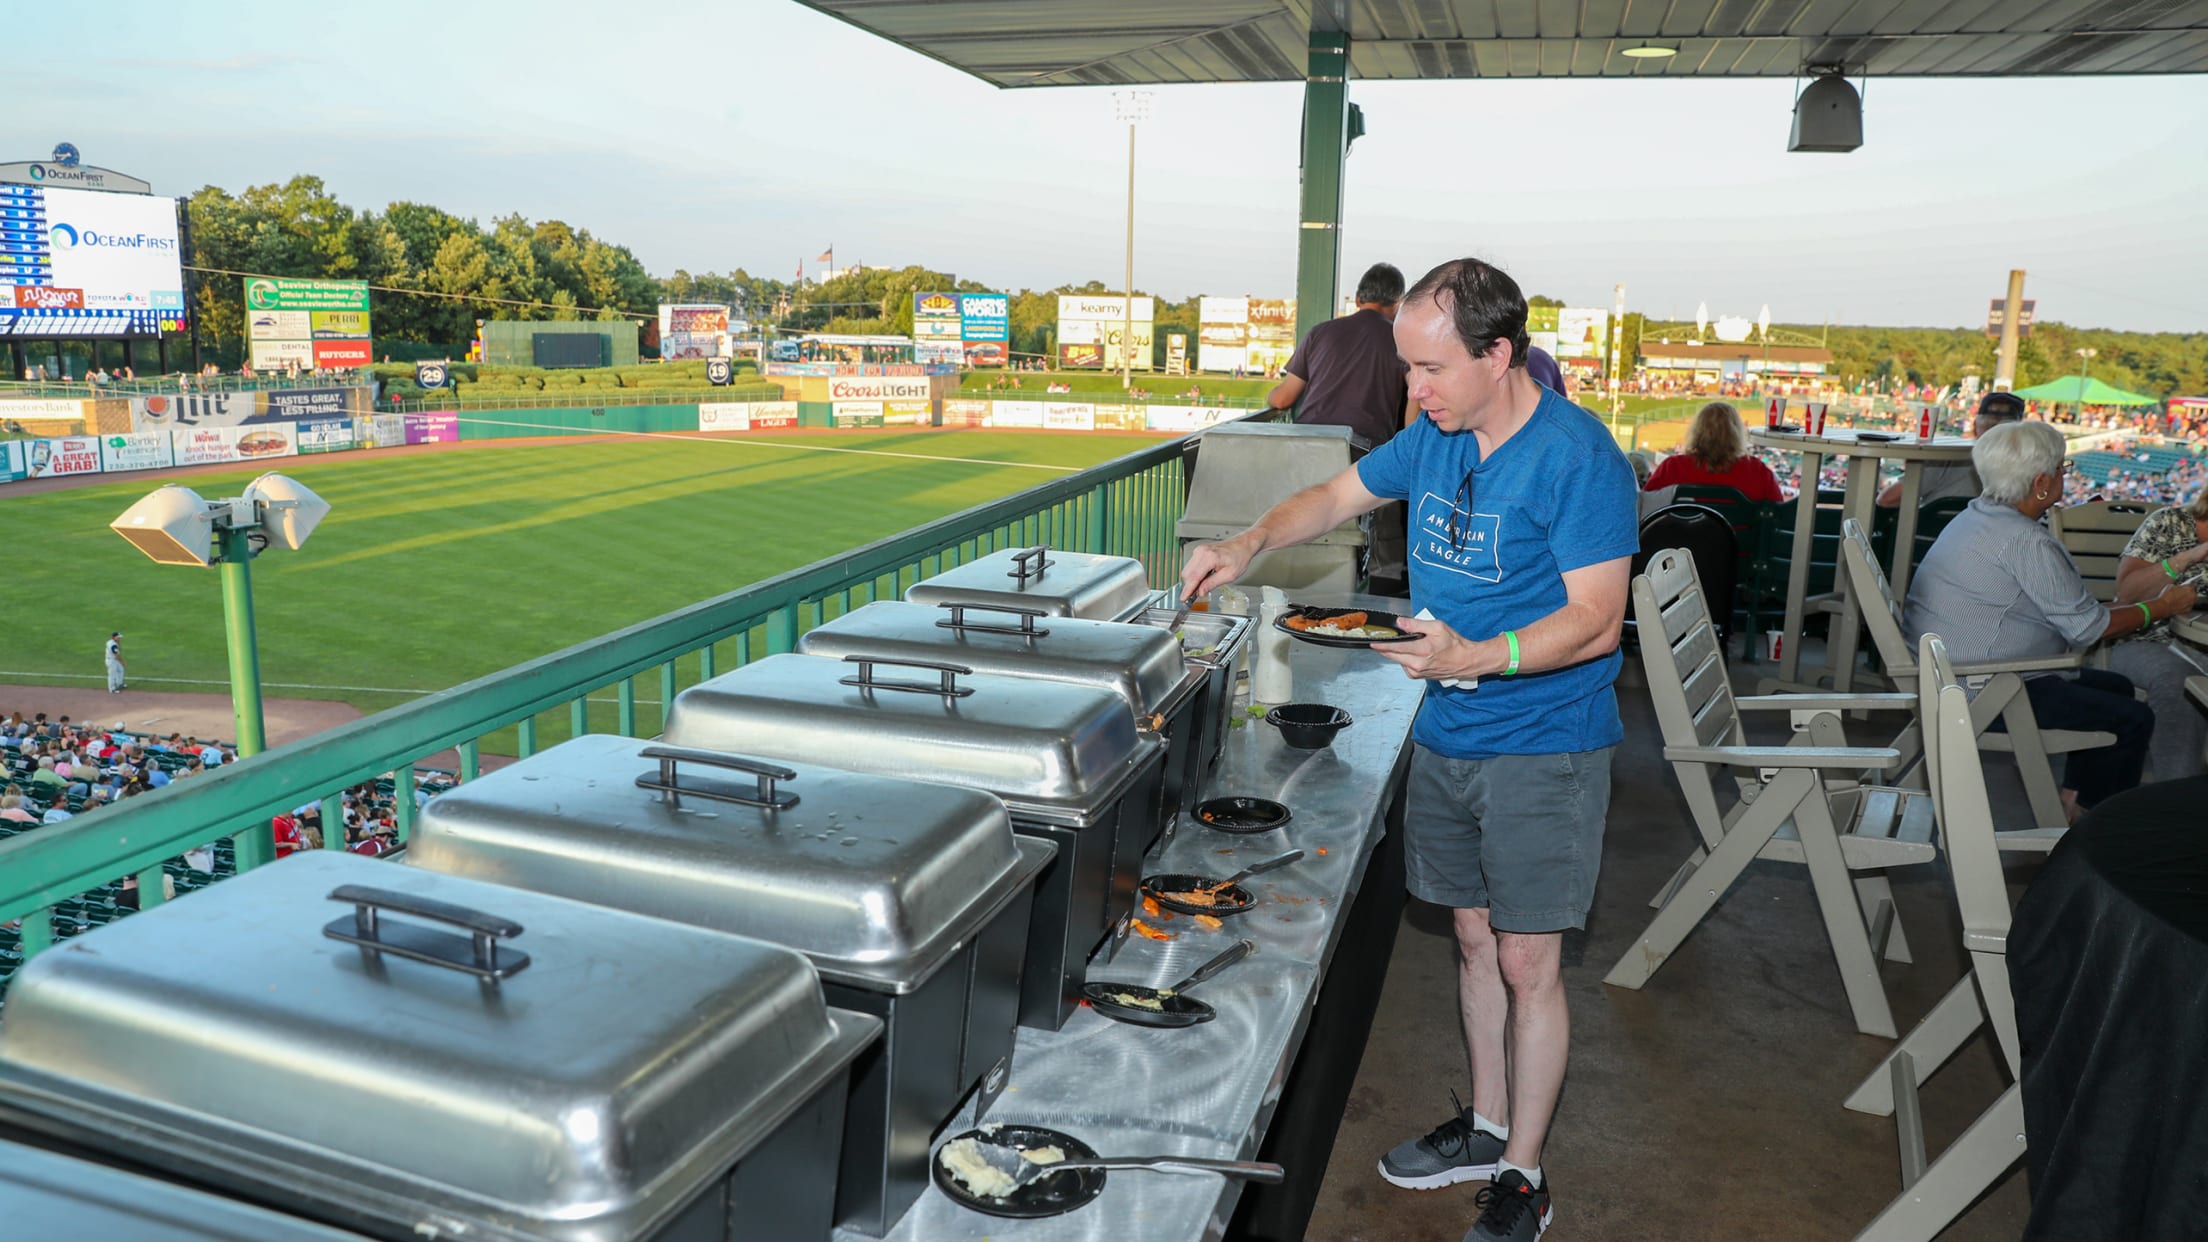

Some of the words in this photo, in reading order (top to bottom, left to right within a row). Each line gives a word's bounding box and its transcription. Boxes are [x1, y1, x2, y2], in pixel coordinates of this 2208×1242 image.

[83, 230, 176, 250] OCEANFIRST
[1080, 302, 1122, 316] kearny
[1250, 303, 1294, 320] xfinity
[423, 369, 442, 383] 29
[711, 365, 727, 377] 19
[832, 380, 881, 398] Coors
[882, 385, 928, 397] LIGHT
[275, 395, 310, 405] TASTES
[311, 393, 343, 403] GREAT,
[175, 393, 230, 425] Lite
[281, 405, 304, 416] LESS
[306, 403, 338, 415] FILLING
[760, 418, 787, 428] LAGER
[194, 433, 220, 442] Wawa
[207, 443, 231, 452] hunger
[53, 454, 59, 463] A
[61, 451, 98, 463] GREAT
[53, 460, 98, 473] GRAB!
[1430, 542, 1472, 566] EAGLE
